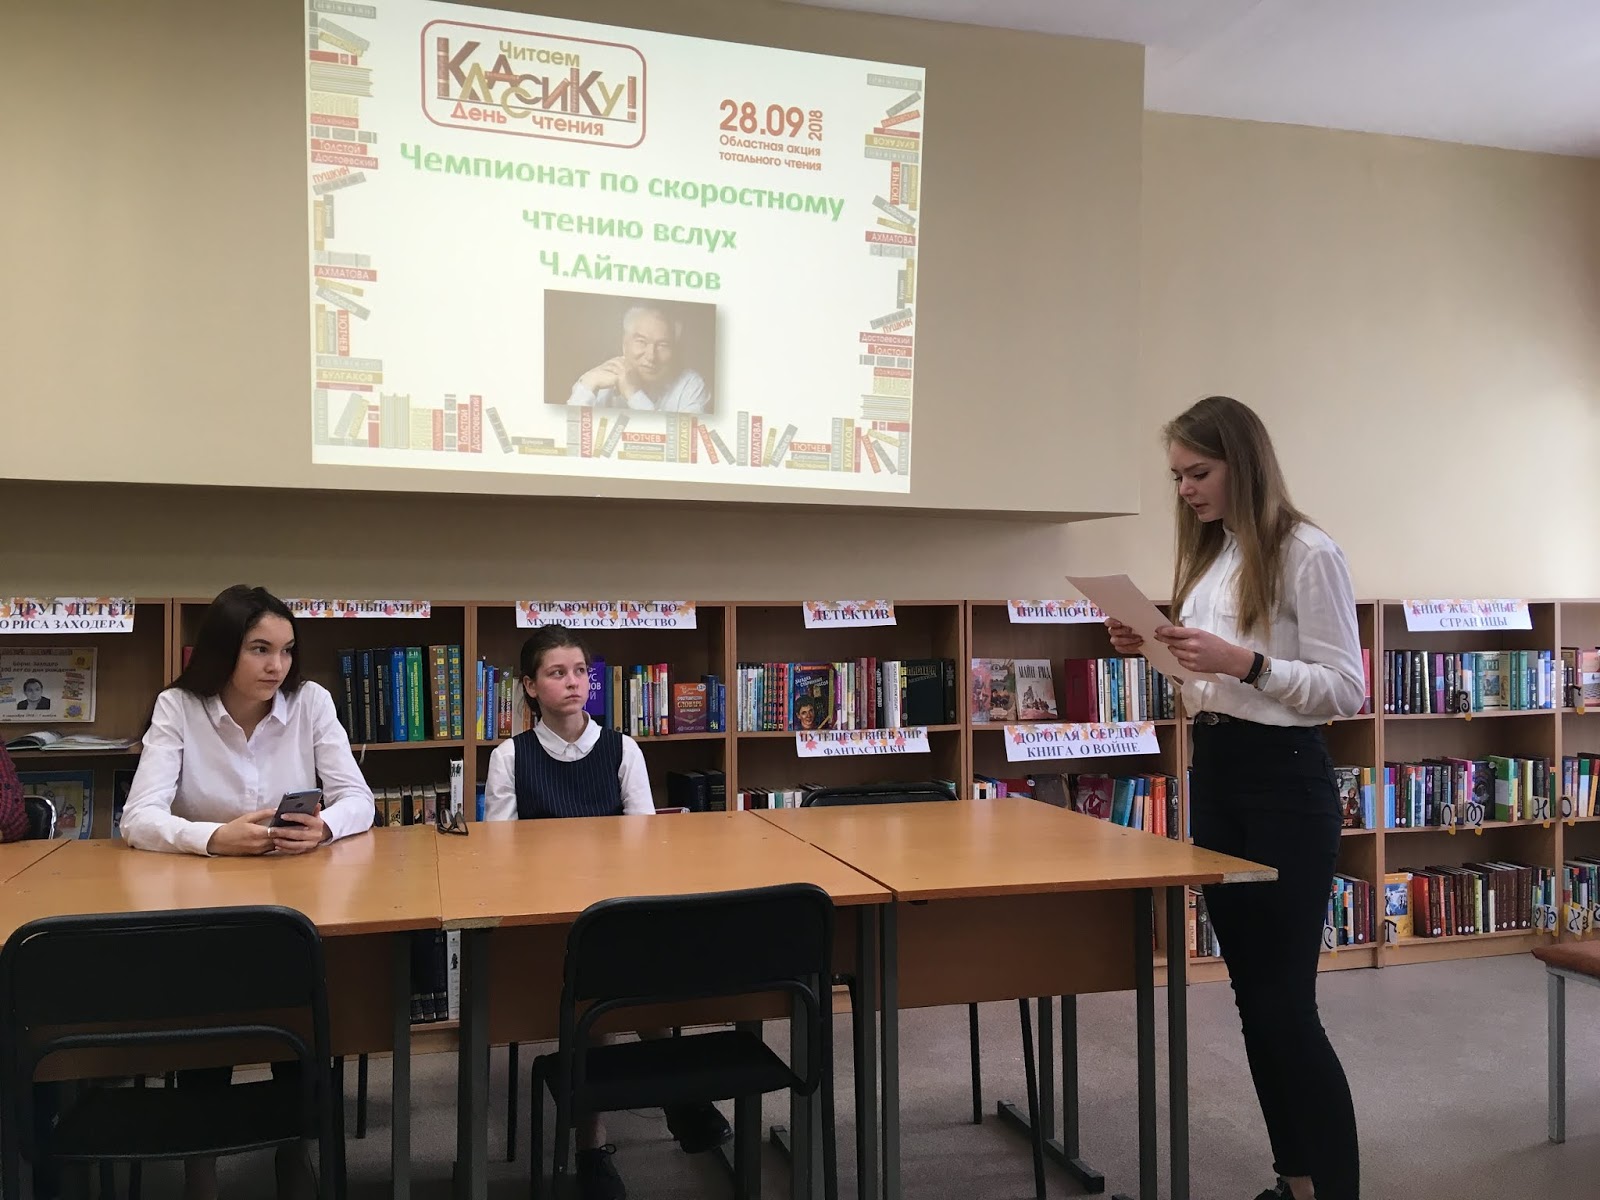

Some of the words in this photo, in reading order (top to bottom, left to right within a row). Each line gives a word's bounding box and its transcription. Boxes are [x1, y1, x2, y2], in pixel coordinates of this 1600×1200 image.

[499, 40, 580, 67] Читаем
[450, 101, 508, 124] День
[532, 116, 604, 136] чтения
[719, 99, 804, 138] 28.09
[808, 110, 823, 141] 2018
[719, 134, 784, 152] Областная
[786, 144, 821, 157] акция
[719, 151, 781, 167] тотального
[784, 159, 821, 171] чтения
[312, 165, 350, 184] ПУШКИН
[400, 142, 590, 190] Чемпионат
[600, 170, 639, 195] по
[648, 176, 845, 221] скоростному
[522, 209, 643, 241] чтению
[653, 220, 737, 253] вслух
[872, 233, 913, 245] АХМАТОВА
[318, 267, 369, 280] АХМАТОВА
[540, 250, 721, 291] Ч.Айтматов
[882, 318, 912, 333] ПУШКИН
[321, 370, 374, 382] БУЛГАКОВ
[582, 411, 591, 456] АХМАТОВА
[625, 432, 662, 443] ТЮТЧЕВ
[680, 414, 689, 458] БУЛГАКОВ
[754, 421, 762, 465] АХМАТОВА
[793, 442, 828, 453] ТЮТЧЕВ
[844, 426, 854, 469] БУЛГАКОВ
[10, 602, 63, 618] ДРУГ
[65, 599, 133, 618] ДЕТЕЙ
[393, 602, 429, 613] МИР!
[529, 602, 617, 613] СПРАВОЧНОЕ
[813, 609, 890, 621] ДЕТЕКТИВ
[1017, 606, 1107, 617] ПРИКЛЮЧЕ
[53, 620, 125, 630] ЗАХОДЕРА
[584, 618, 677, 627] ГОСУДАРСТВО
[1440, 617, 1508, 628] СТРАНИЦЫ
[1018, 664, 1036, 679] МАЙН
[800, 731, 889, 742] ПУТЕШЕСТВИЕ
[889, 731, 896, 740] В
[897, 730, 922, 740] МИР
[1017, 730, 1080, 744] ДОРОГАЯ
[1090, 728, 1140, 740] СЕРДЦУ
[824, 745, 906, 755] ФАНТАСТИКИ
[1027, 746, 1074, 758] КНИГА
[1080, 745, 1090, 755] О
[1094, 740, 1141, 754] ВОЙНЕ
